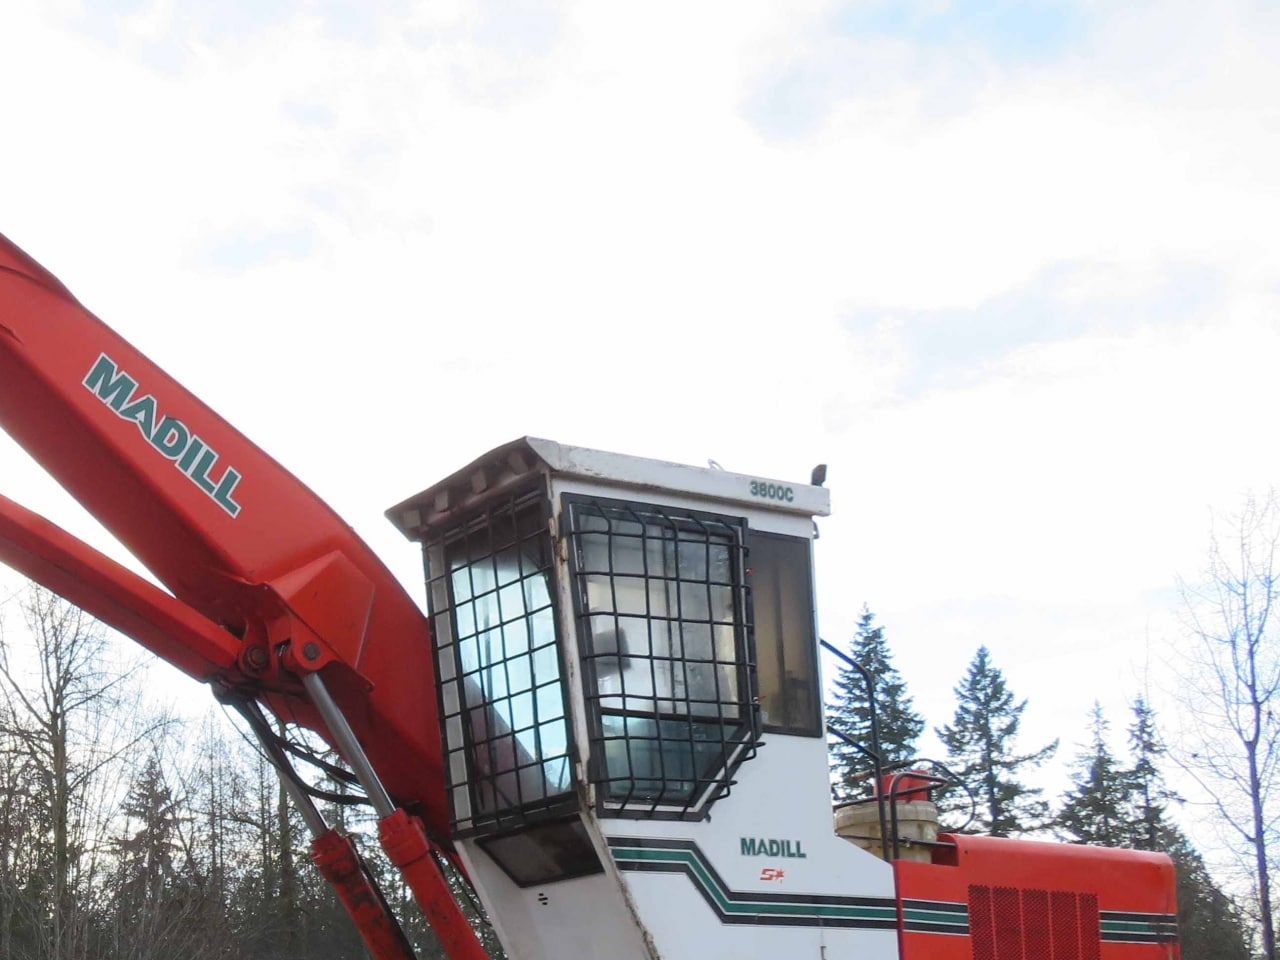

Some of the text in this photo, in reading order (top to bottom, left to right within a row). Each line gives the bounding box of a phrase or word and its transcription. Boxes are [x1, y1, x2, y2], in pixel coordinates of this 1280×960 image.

[82, 352, 242, 519] MADILL
[750, 480, 794, 503] 3800C
[740, 837, 807, 858] MADILL
